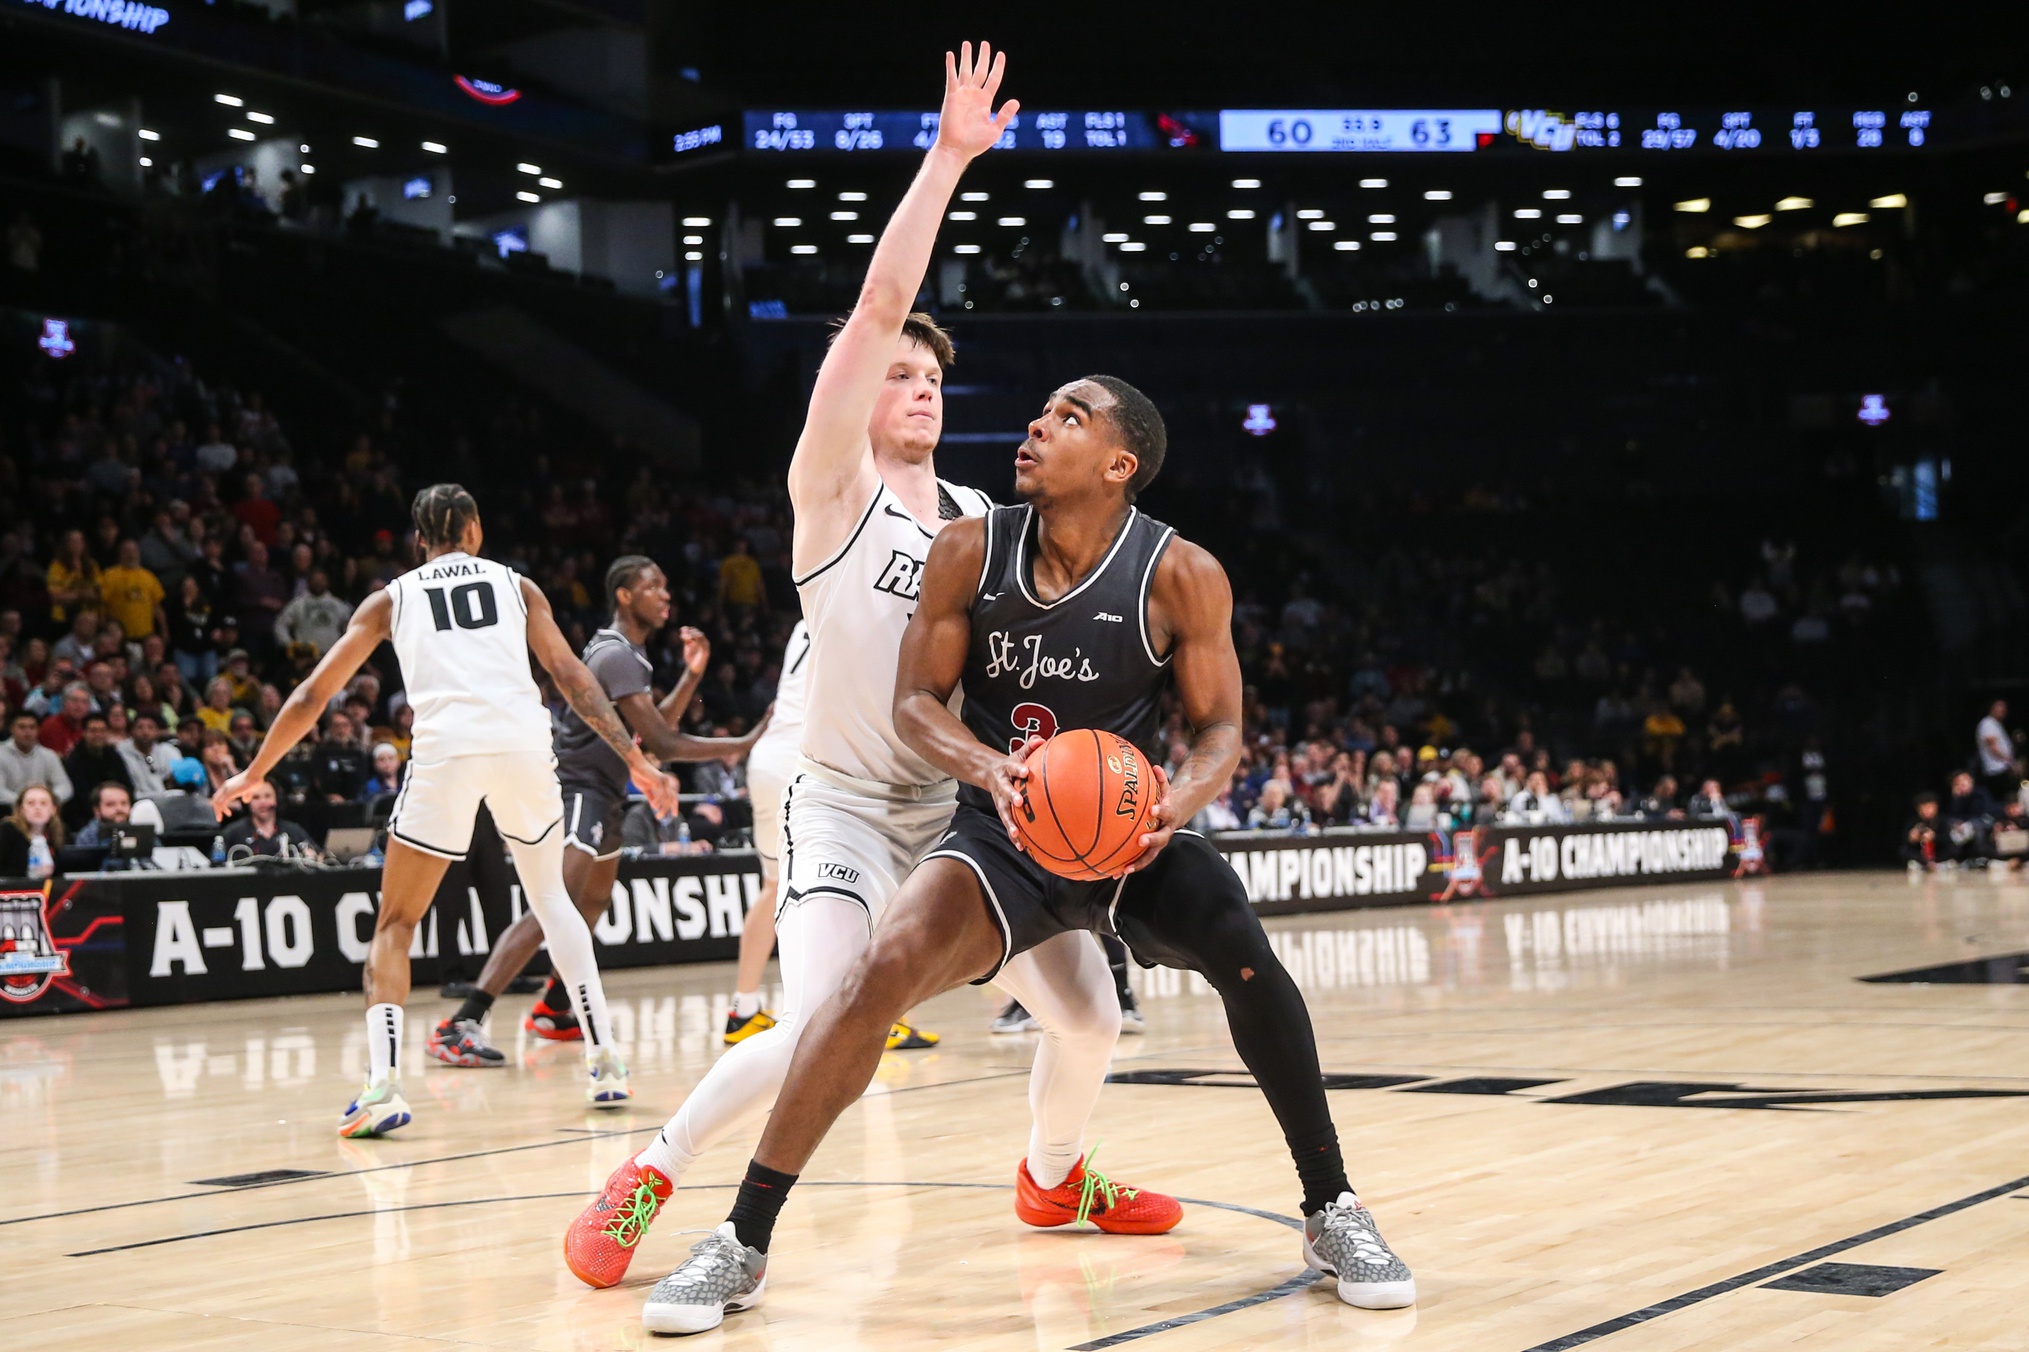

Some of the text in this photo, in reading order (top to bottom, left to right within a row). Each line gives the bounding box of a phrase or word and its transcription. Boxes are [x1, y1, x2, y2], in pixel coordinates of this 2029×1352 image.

[1269, 119, 1312, 145] 60
[1411, 119, 1450, 145] 63
[418, 563, 486, 580] LAWAL
[423, 582, 498, 632] 10
[1093, 612, 1123, 623] A10
[1019, 634, 1100, 690] Joe's
[818, 863, 860, 884] VCU
[1224, 843, 1427, 903] AMPIONSHIP
[1502, 827, 1728, 883] A-10 CHAMPIONSHIP
[150, 895, 314, 977] A-10
